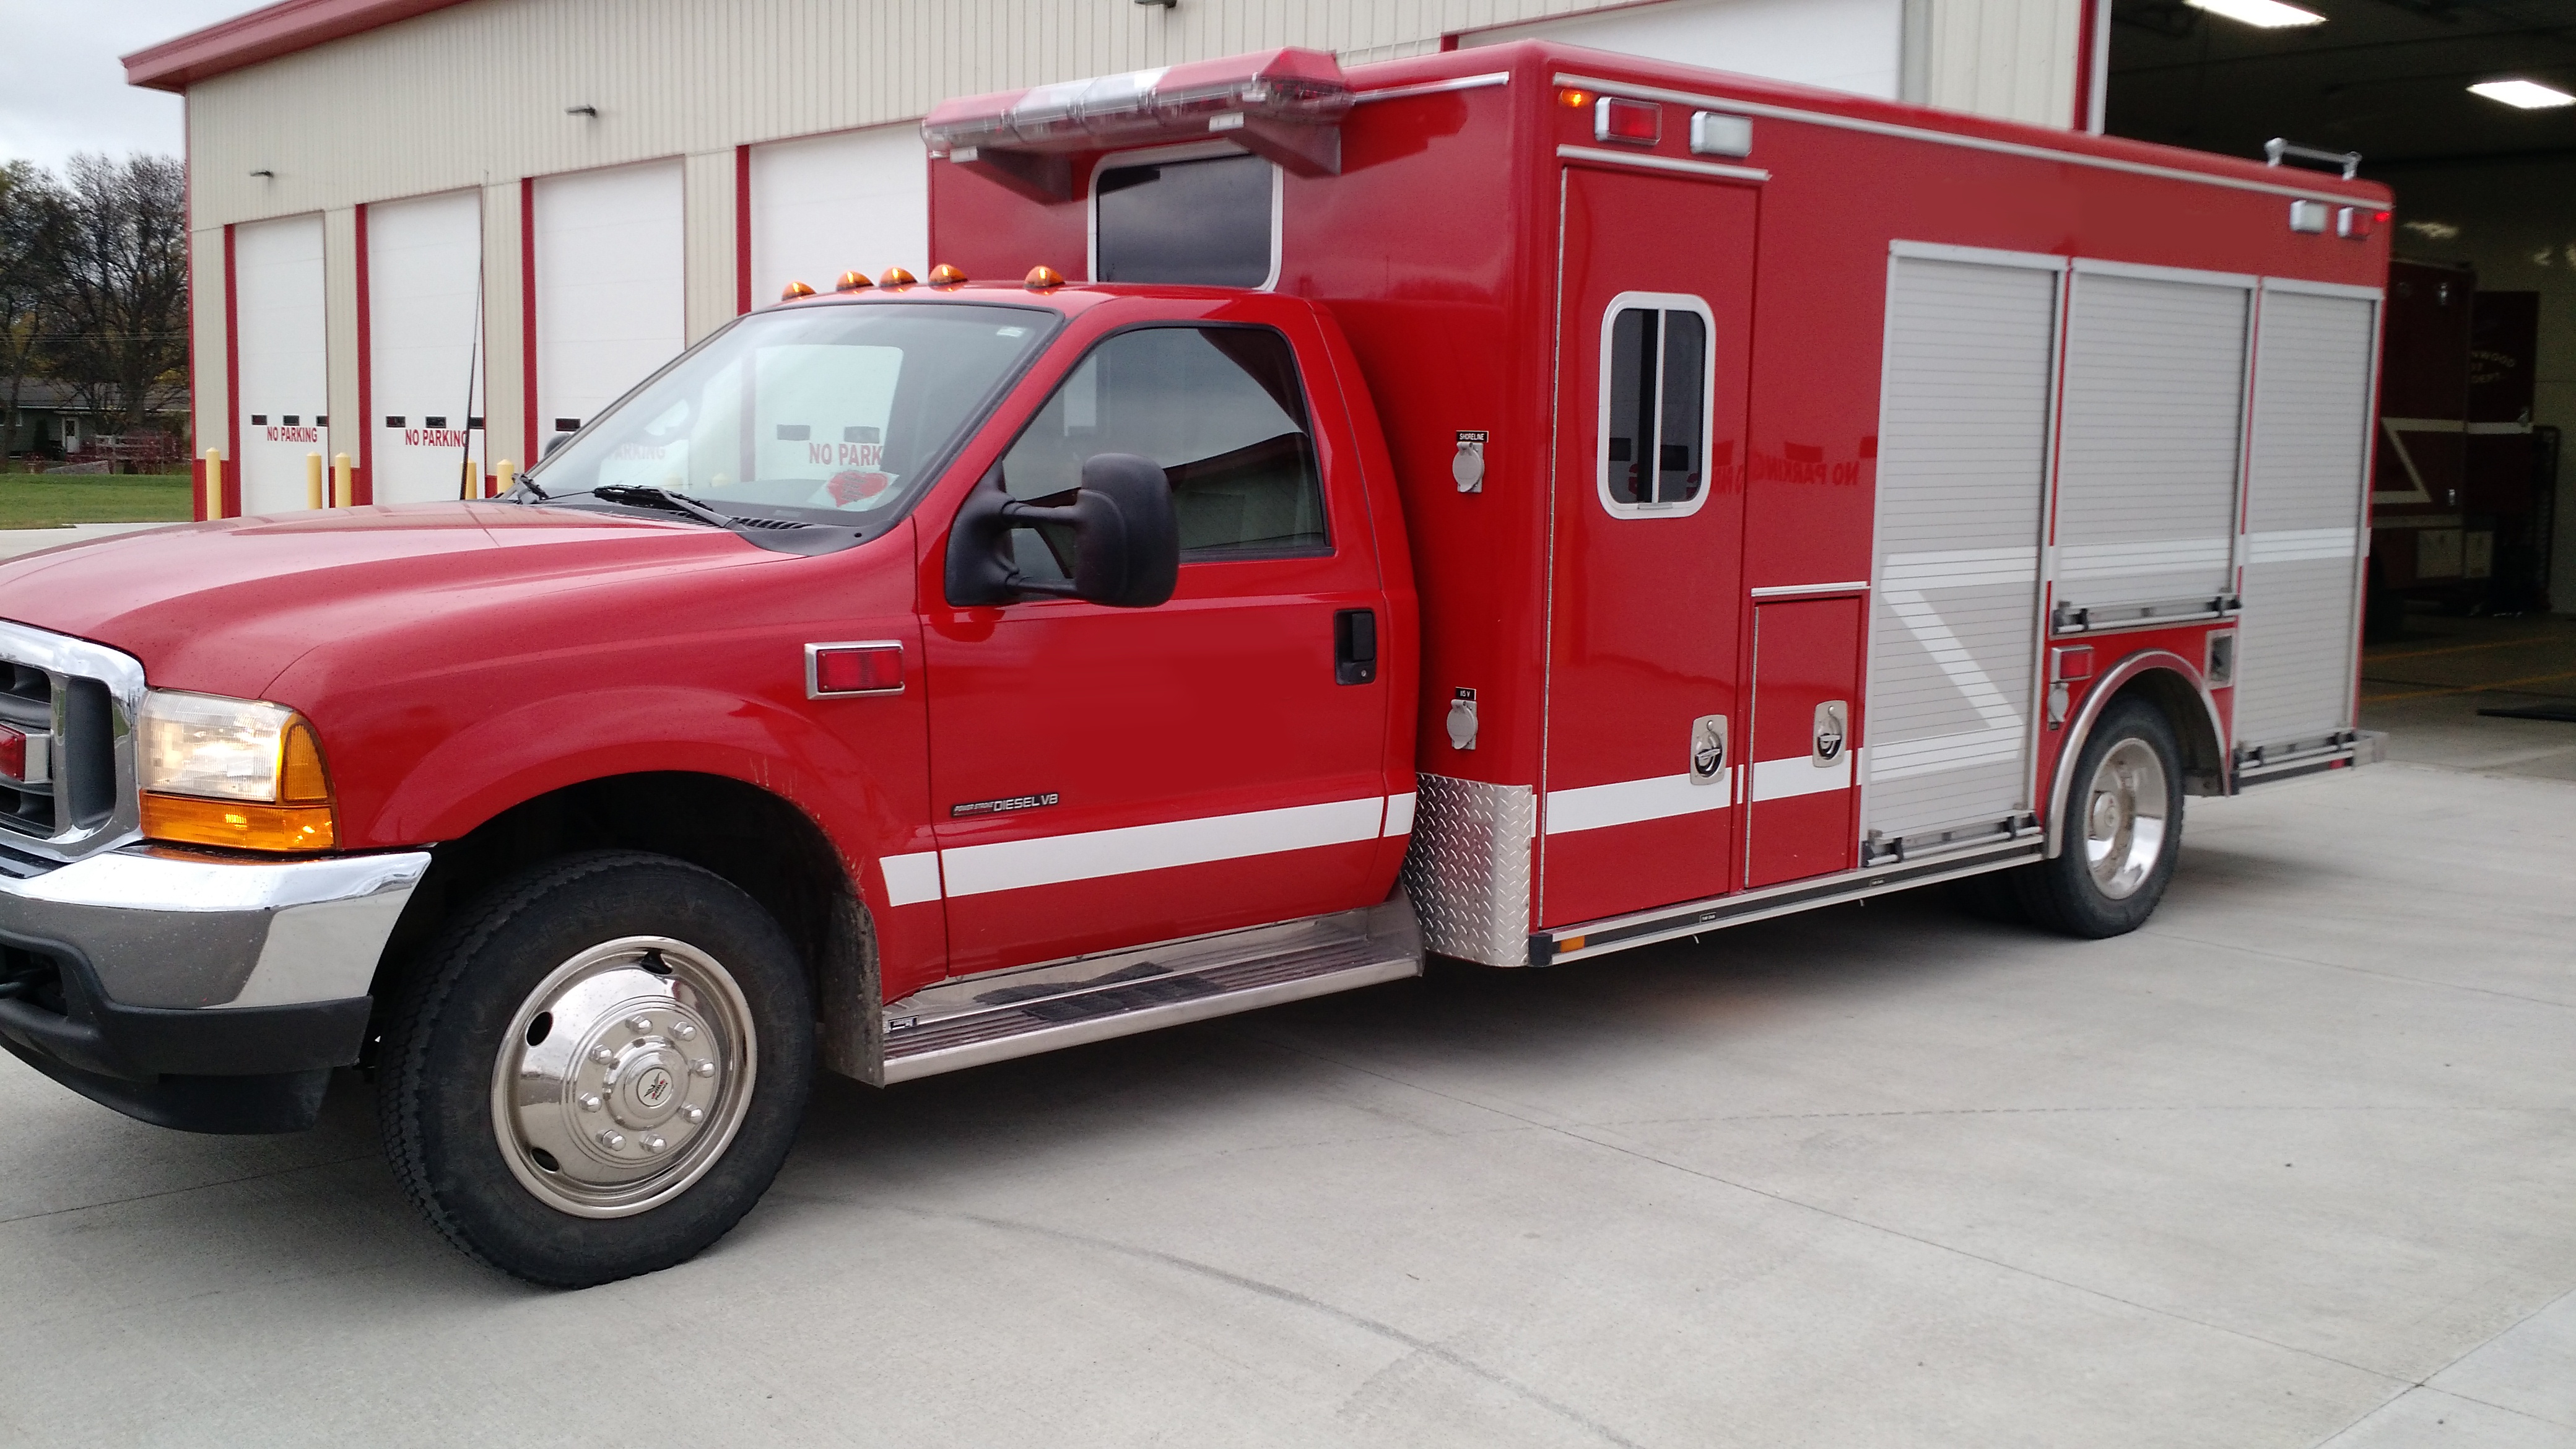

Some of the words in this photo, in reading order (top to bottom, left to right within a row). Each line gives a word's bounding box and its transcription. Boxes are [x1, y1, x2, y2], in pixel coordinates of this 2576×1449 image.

[267, 426, 278, 442] NO
[281, 427, 318, 443] PARKING
[405, 429, 419, 446] NO
[809, 442, 832, 465] NO
[993, 796, 1040, 811] DIESEL
[1040, 793, 1058, 806] V8
